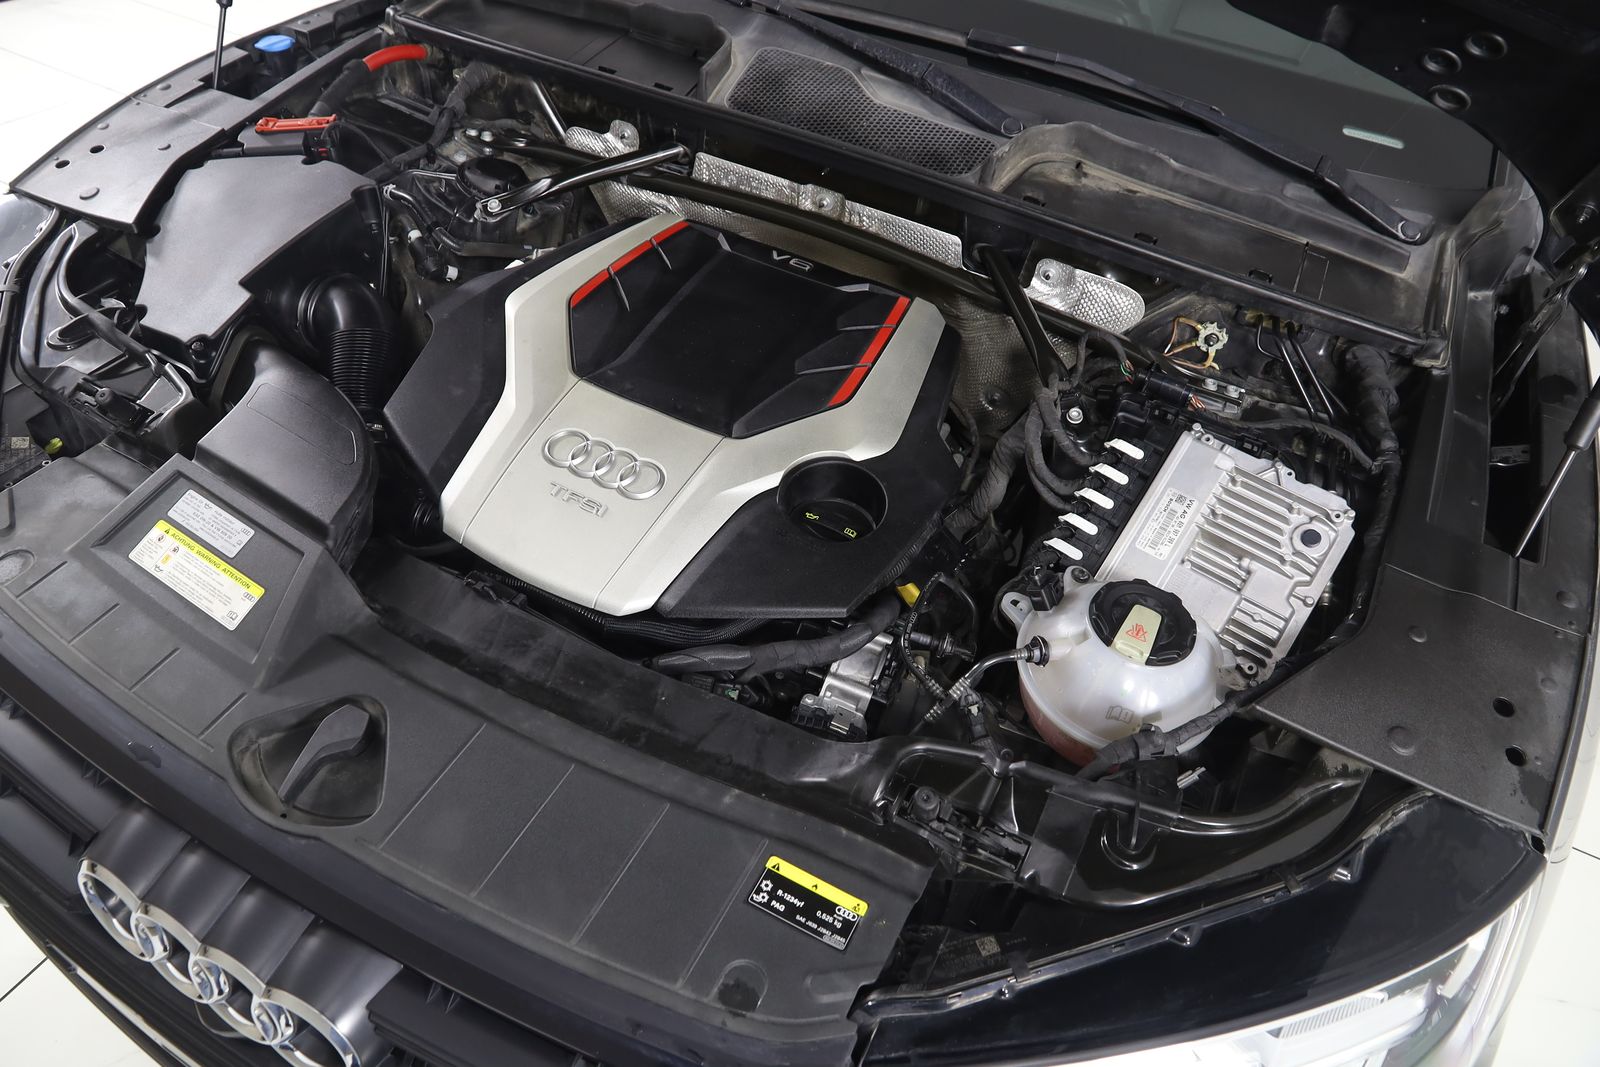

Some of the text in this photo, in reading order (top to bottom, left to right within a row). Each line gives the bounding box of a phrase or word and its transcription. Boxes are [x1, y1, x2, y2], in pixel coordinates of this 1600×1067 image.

[772, 250, 814, 272] V6
[550, 481, 608, 518] TFSI
[1163, 498, 1174, 512] BOSCH
[1179, 499, 1195, 519] VW AG
[171, 532, 196, 552] ACHTUNG
[196, 549, 222, 569] WARNING
[222, 567, 252, 590] ATTENTION
[770, 900, 786, 912] PAG
[776, 889, 805, 908] R-1234yf
[833, 919, 842, 929] kg
